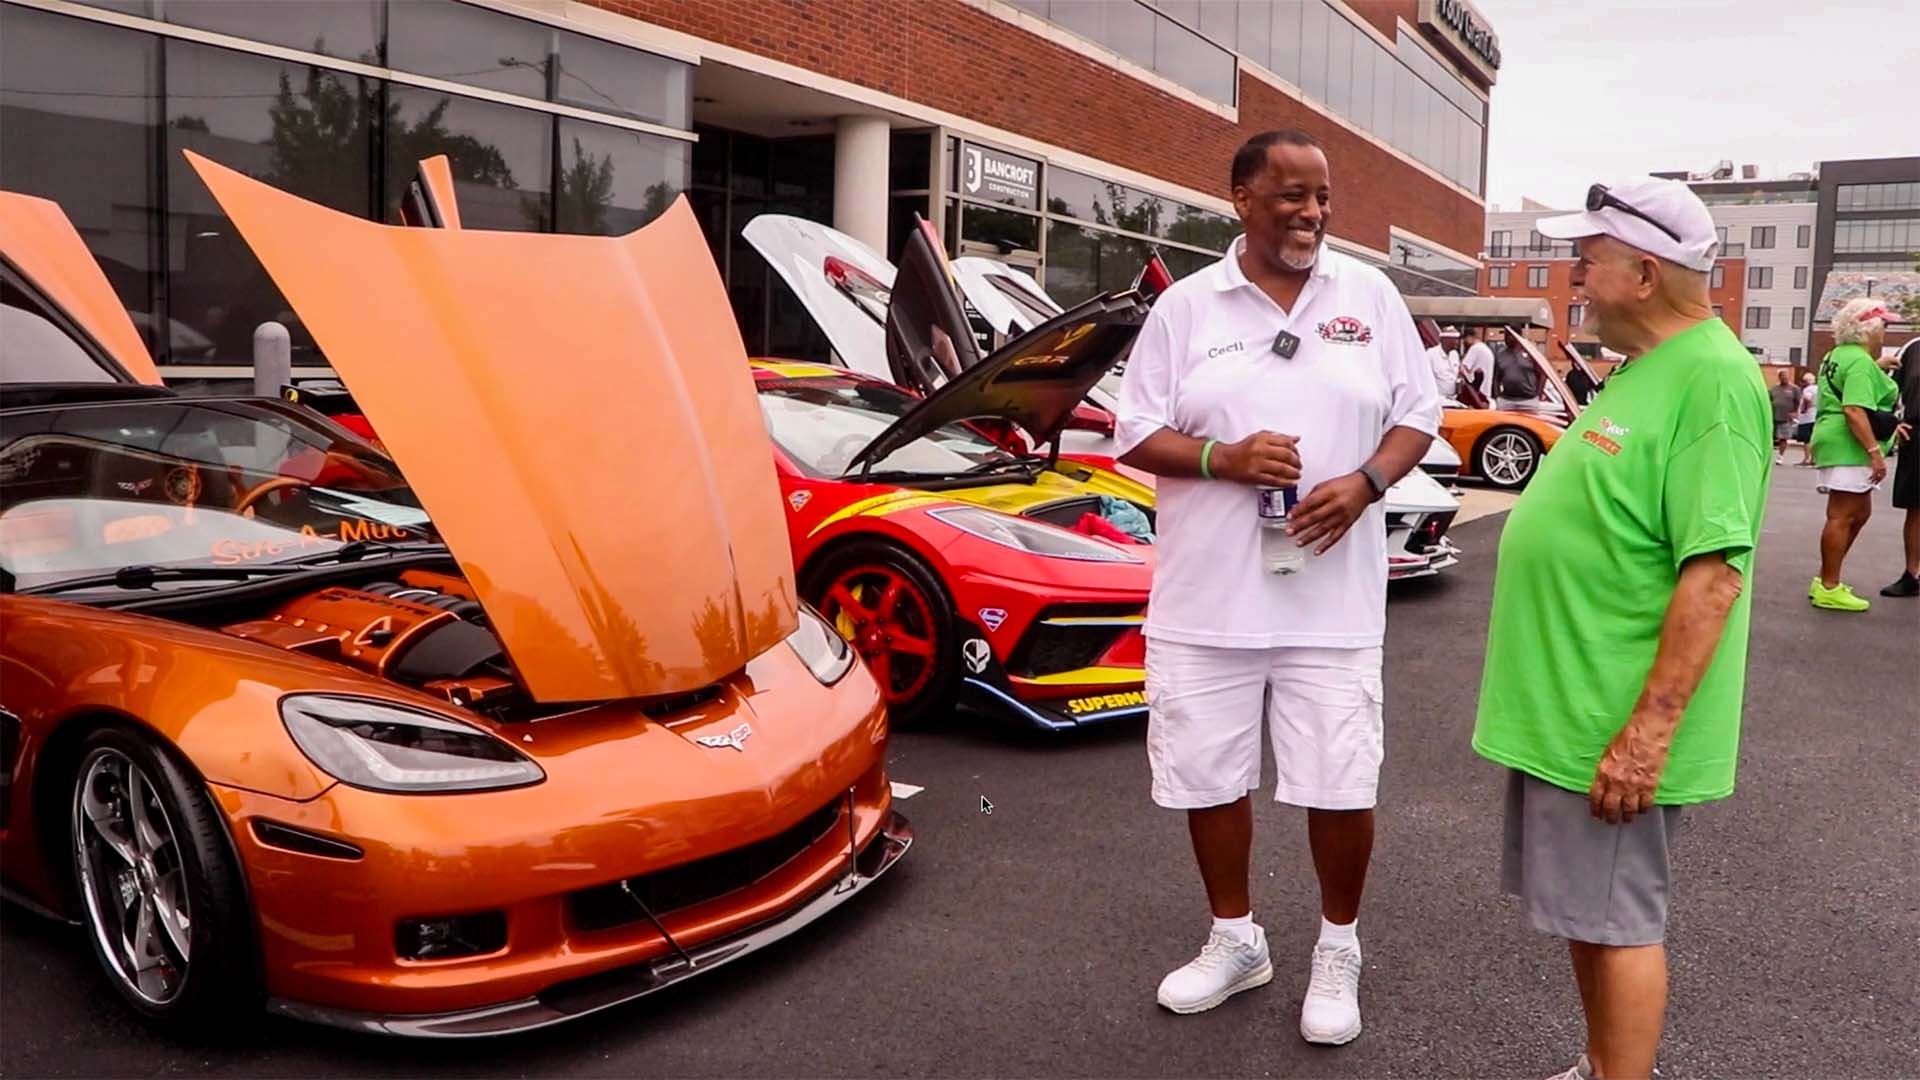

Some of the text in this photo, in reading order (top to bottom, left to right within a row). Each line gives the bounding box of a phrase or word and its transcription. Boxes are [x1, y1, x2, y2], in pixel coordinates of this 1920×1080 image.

[984, 158, 1034, 185] BANCROFT
[988, 182, 1030, 198] CONSTRUCTION
[1208, 341, 1244, 359] Cecil
